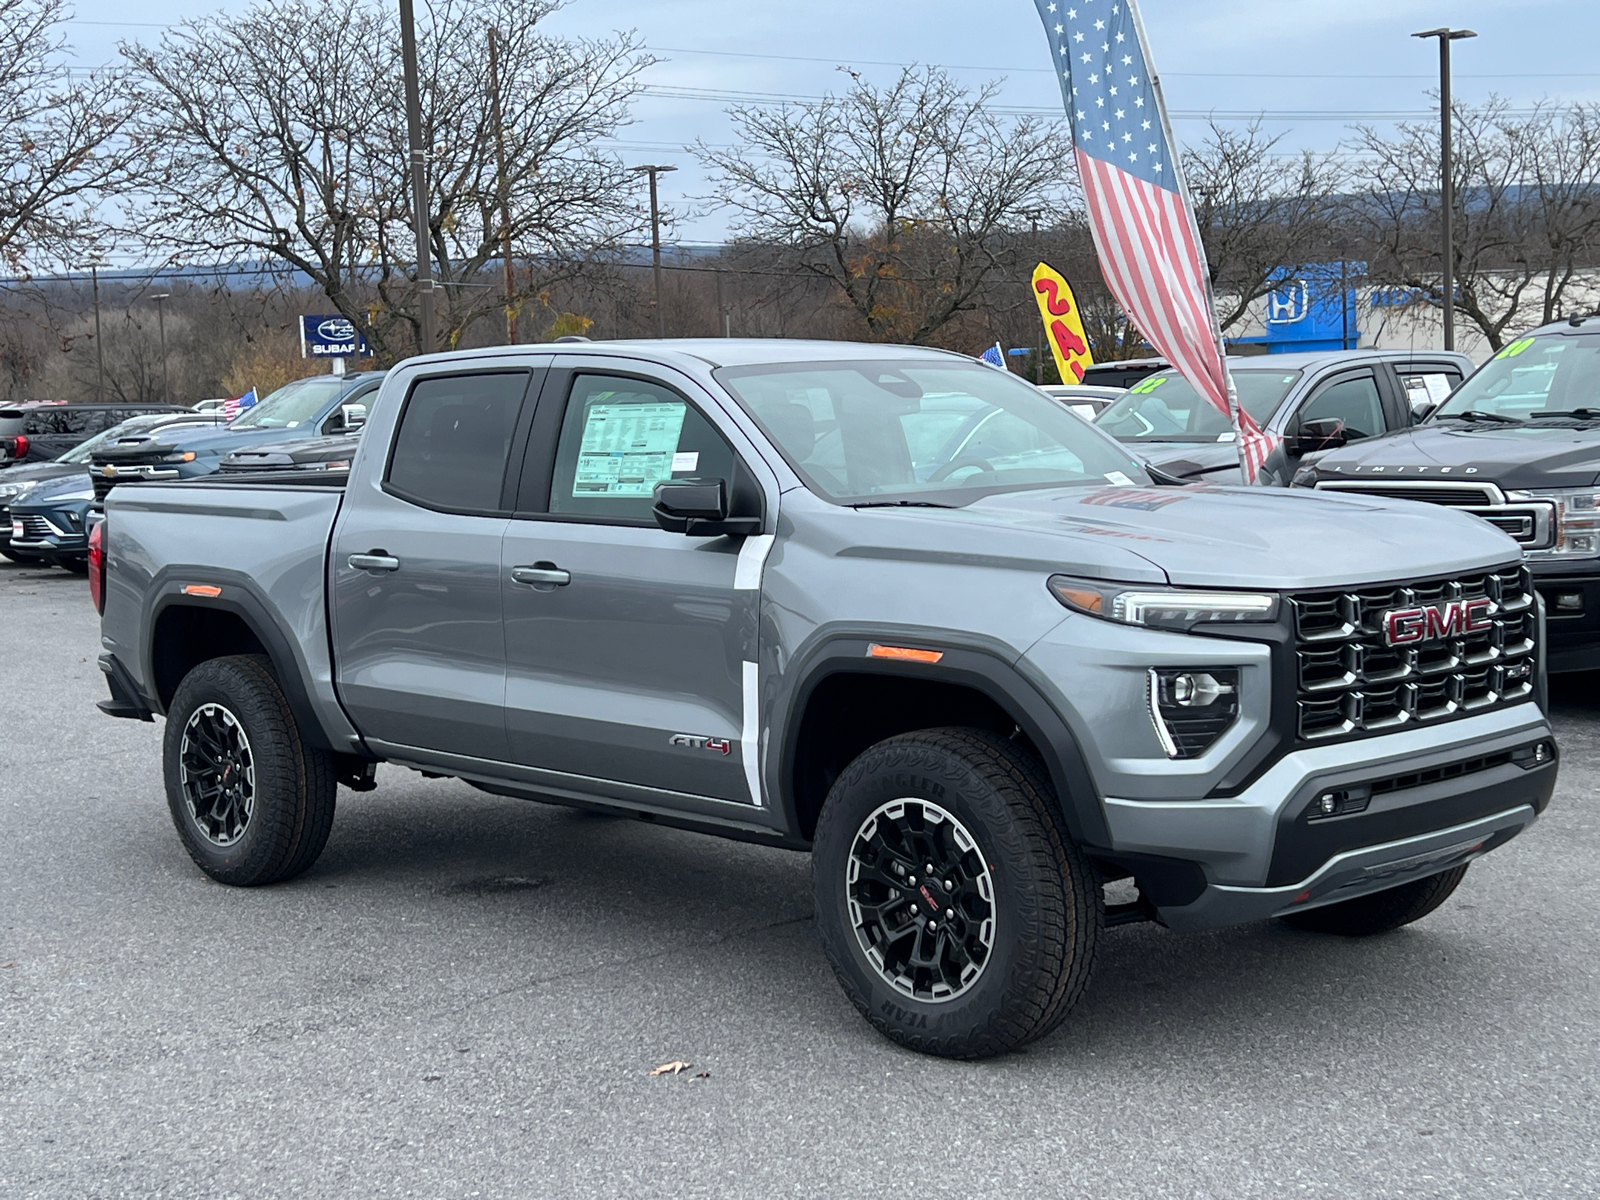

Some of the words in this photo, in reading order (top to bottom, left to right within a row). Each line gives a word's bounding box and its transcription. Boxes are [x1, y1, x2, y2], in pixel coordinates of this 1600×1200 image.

[313, 344, 365, 354] SUBARU
[1494, 337, 1536, 360] 20
[1131, 377, 1167, 394] 22
[1334, 466, 1478, 474] LIMITED
[1383, 597, 1492, 647] GMC
[668, 733, 730, 756] AT4
